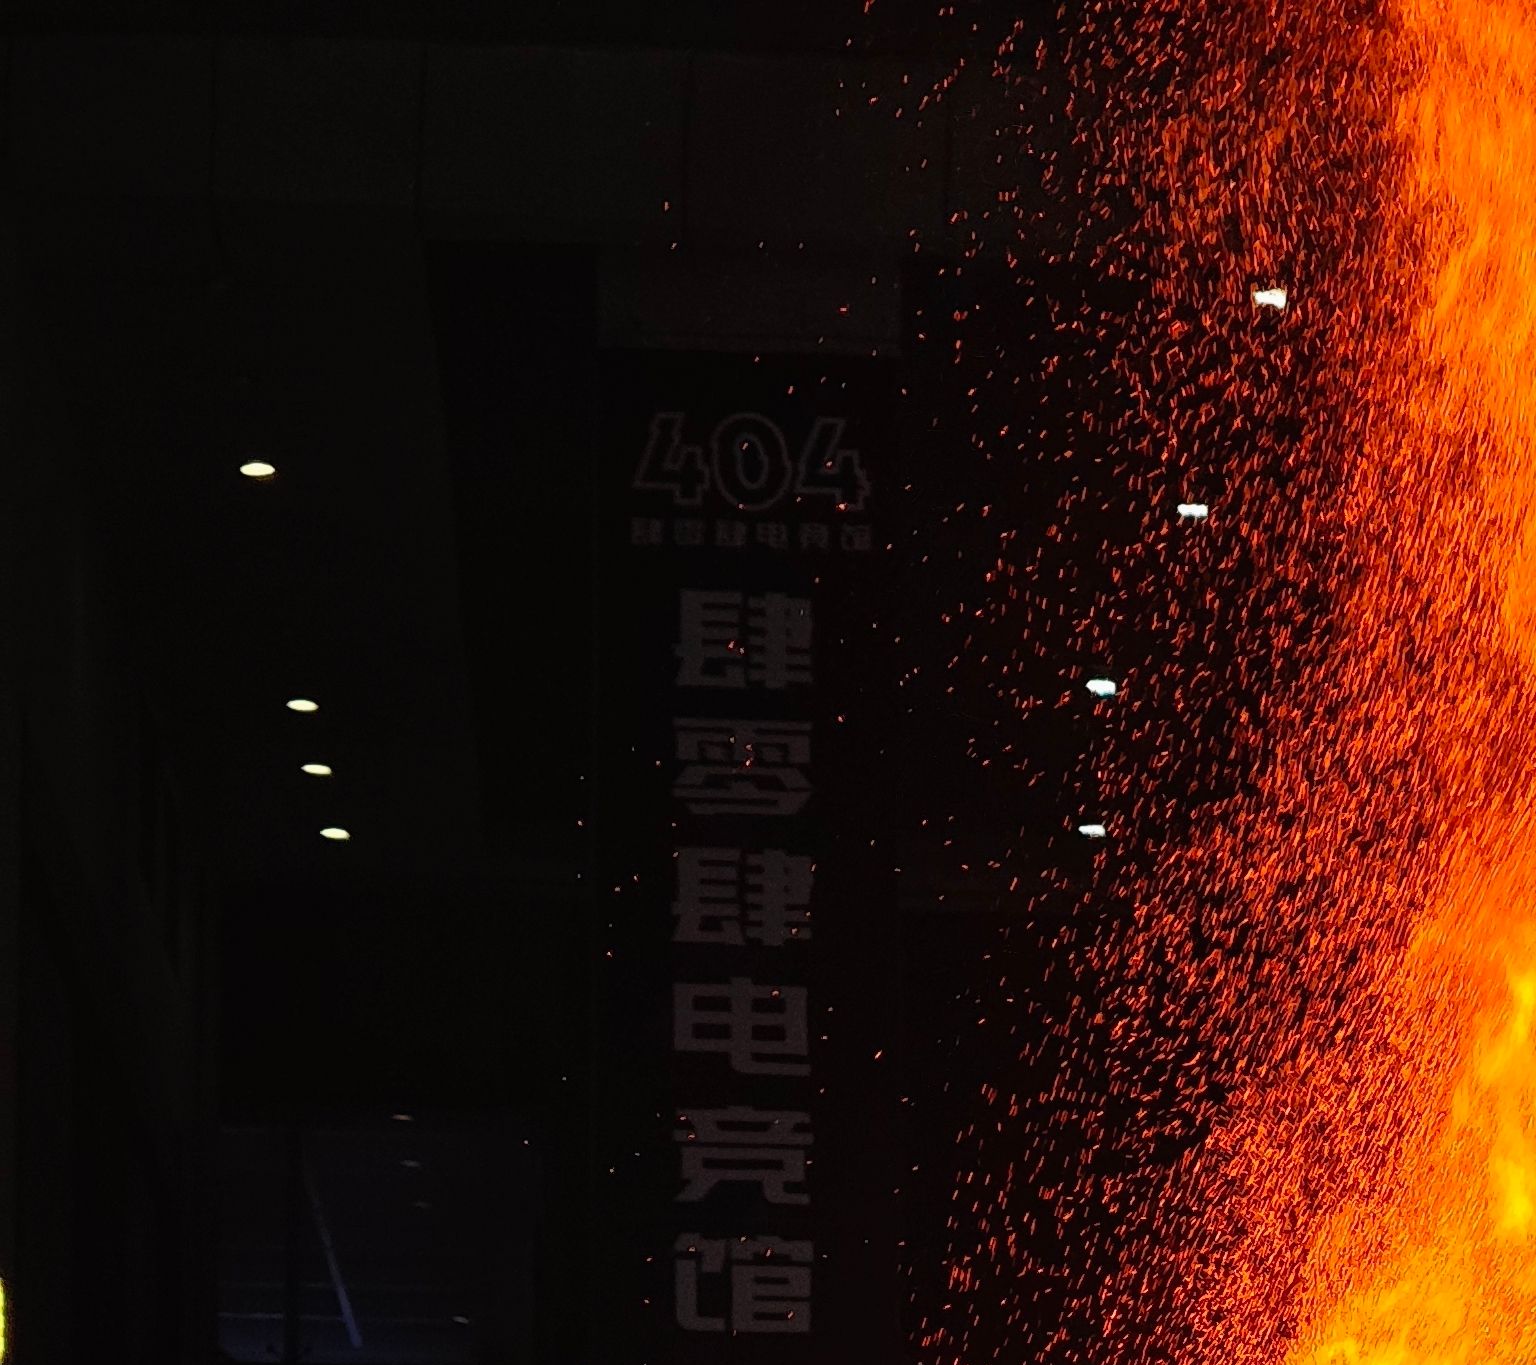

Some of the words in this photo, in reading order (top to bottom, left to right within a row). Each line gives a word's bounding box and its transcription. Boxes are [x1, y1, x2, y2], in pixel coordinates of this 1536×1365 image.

[631, 411, 872, 511] 404
[672, 589, 815, 1332] 肆零肆电竞馆
